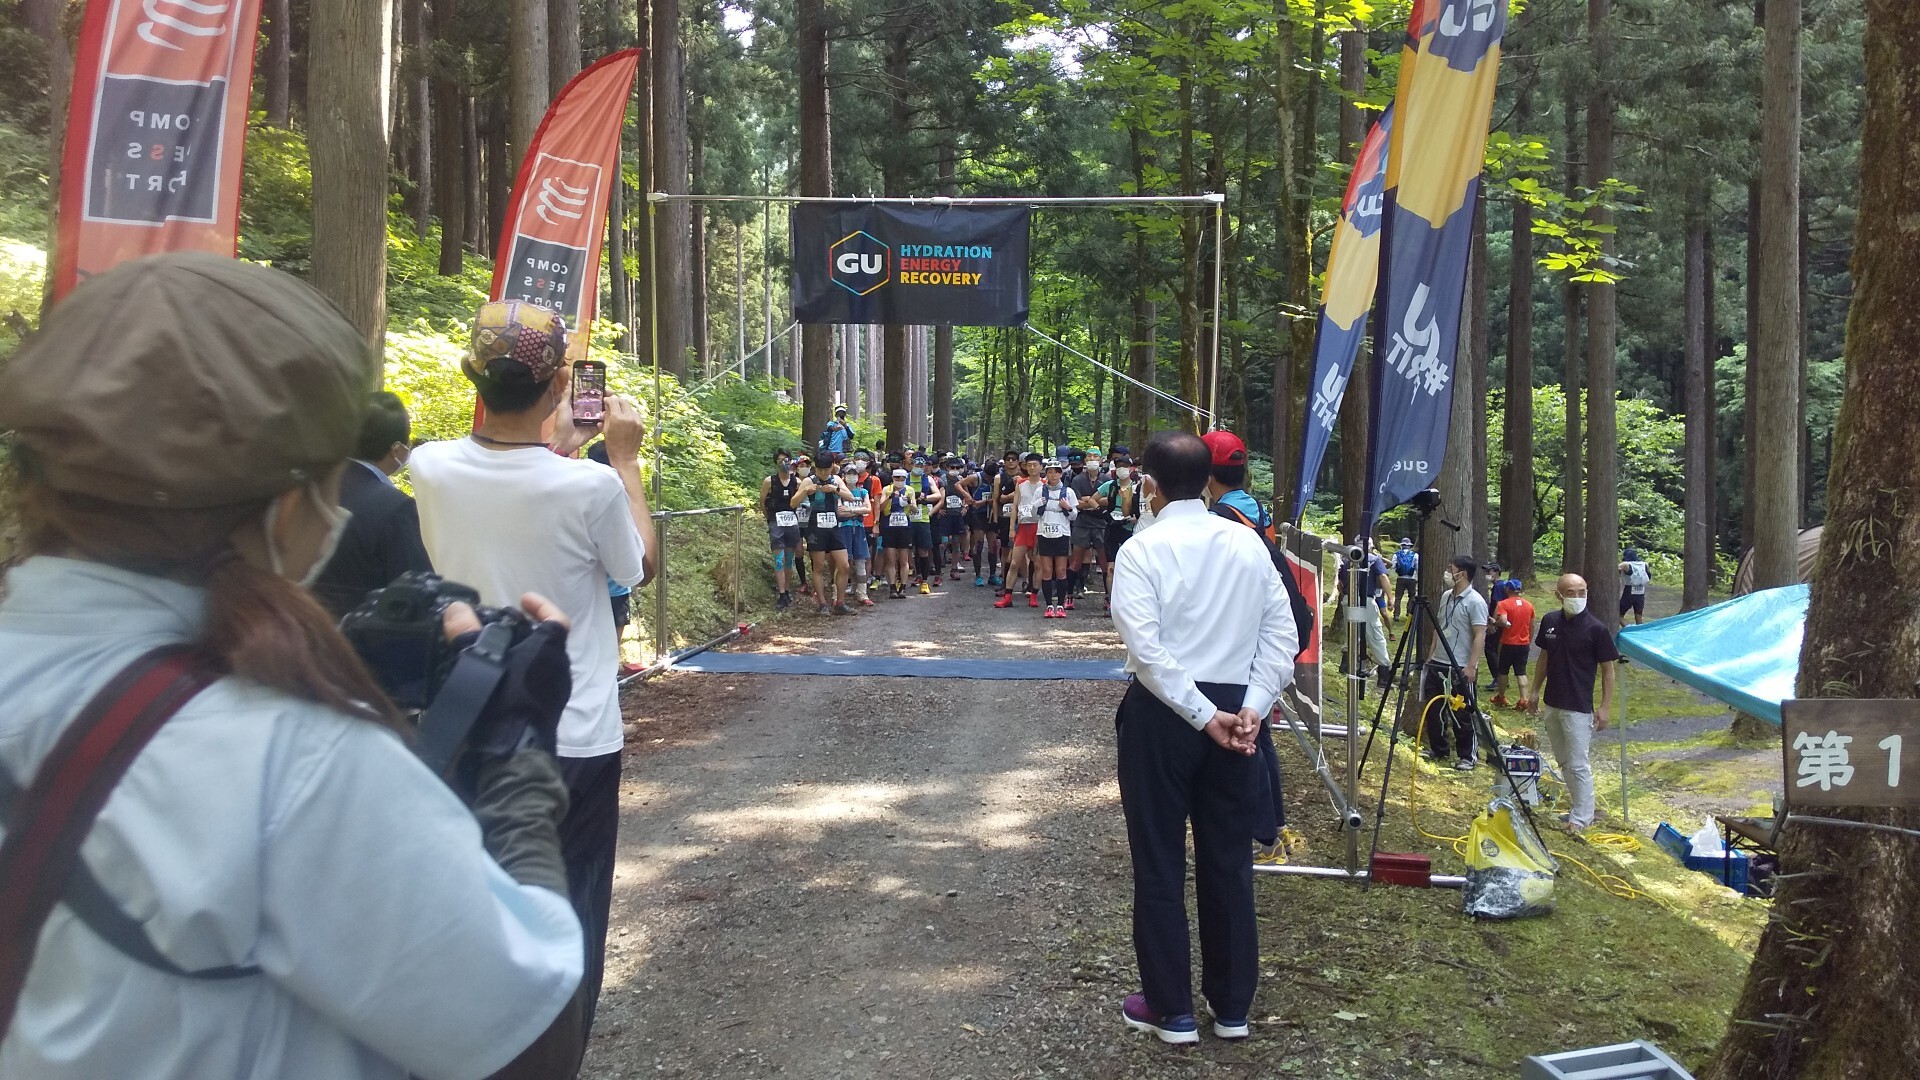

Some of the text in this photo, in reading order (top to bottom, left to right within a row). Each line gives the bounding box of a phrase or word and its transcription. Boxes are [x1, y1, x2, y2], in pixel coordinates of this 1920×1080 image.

[901, 244, 992, 259] HYDRATION
[836, 253, 883, 275] GU
[901, 257, 962, 272] ENERGY
[900, 271, 982, 286] RECOVERY
[1044, 525, 1059, 533] 1155
